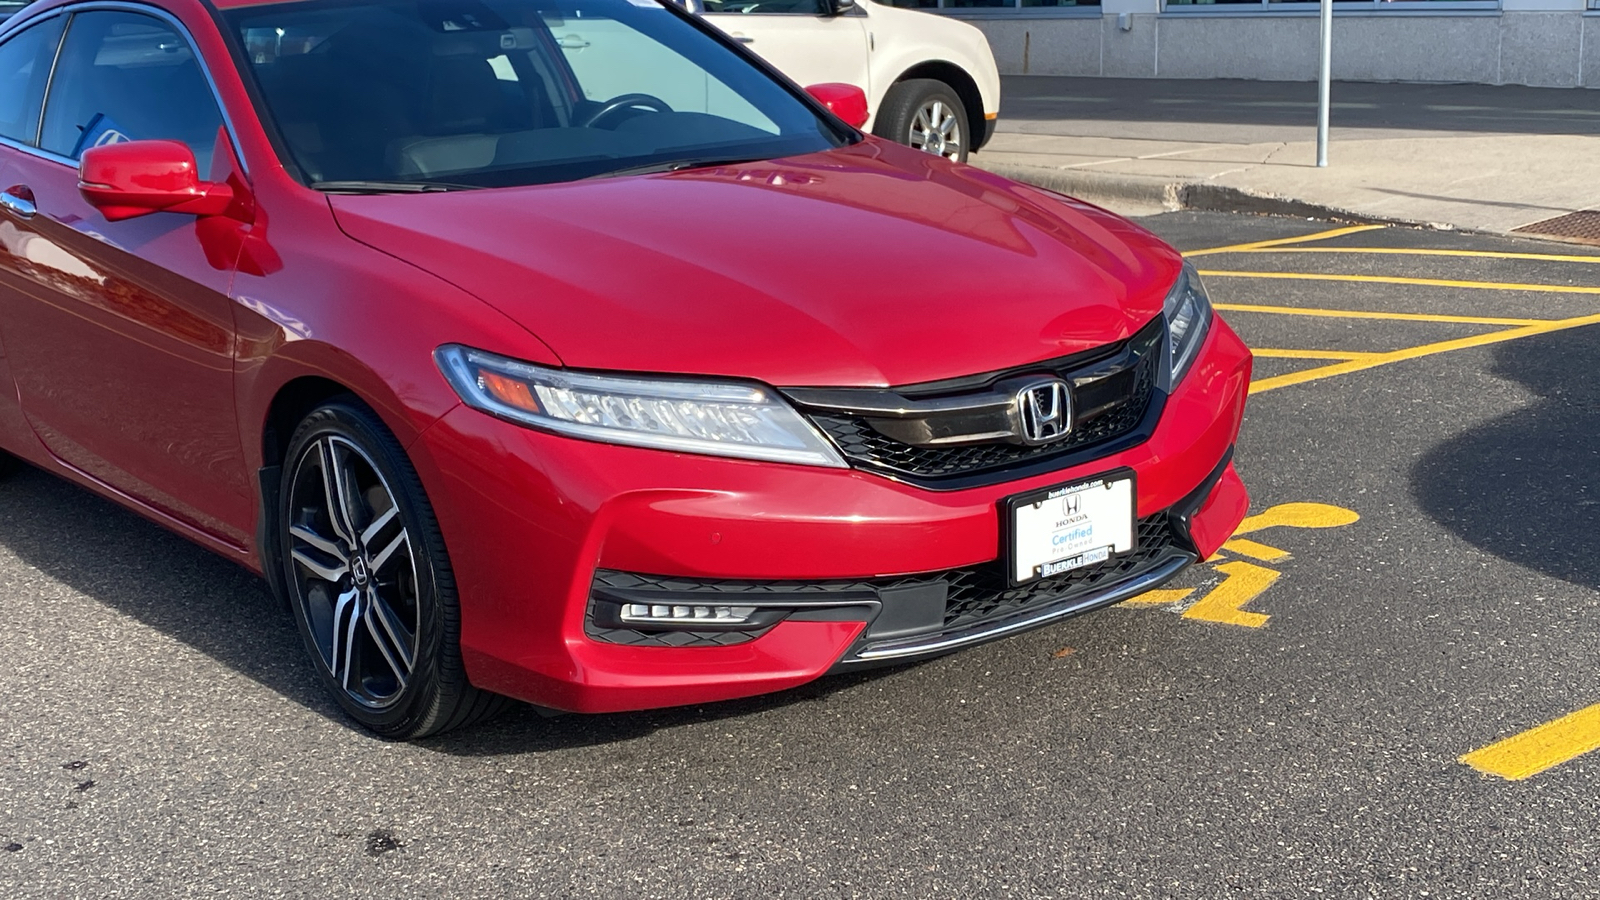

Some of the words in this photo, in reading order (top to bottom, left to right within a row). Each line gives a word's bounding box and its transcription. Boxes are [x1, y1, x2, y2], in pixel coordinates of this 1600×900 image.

[1048, 480, 1104, 499] buerklehonda.com
[1055, 513, 1088, 528] HONDA
[1052, 524, 1092, 546] Certified
[1043, 556, 1083, 577] BUERKLE
[1083, 550, 1107, 564] HONDA
